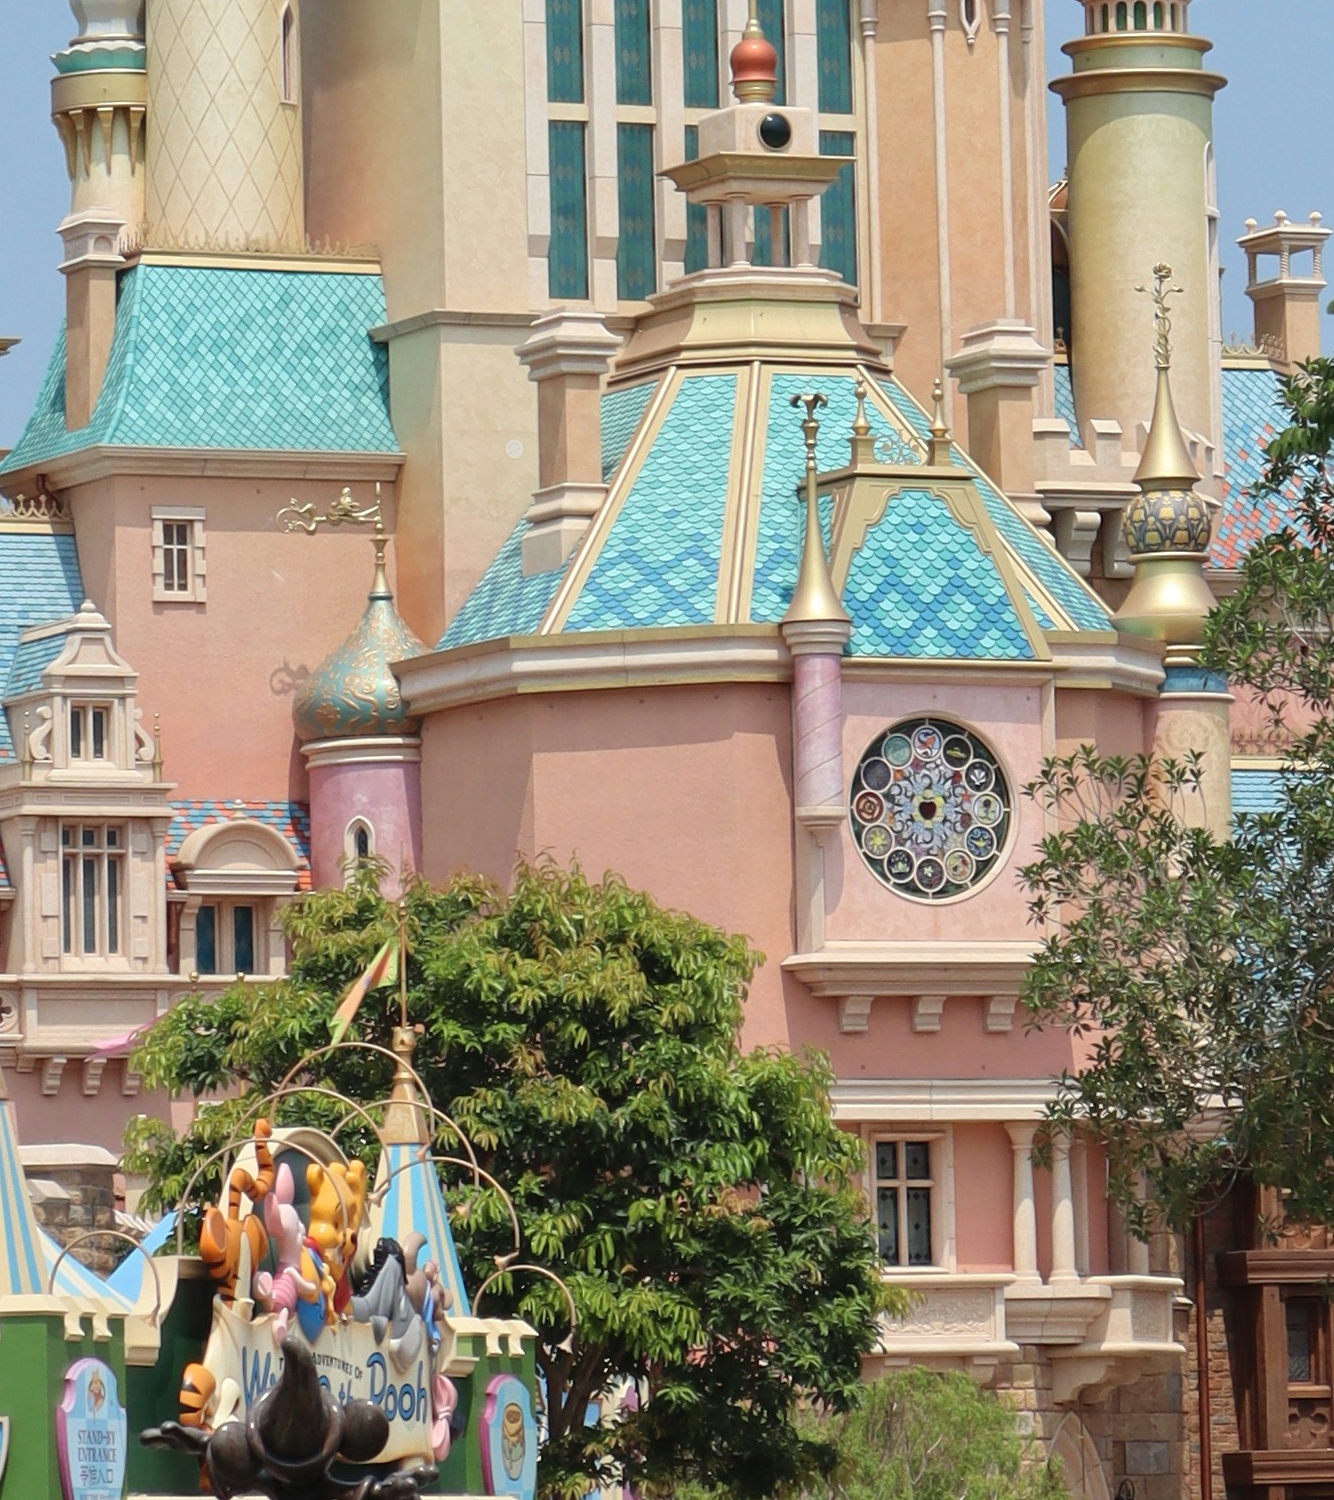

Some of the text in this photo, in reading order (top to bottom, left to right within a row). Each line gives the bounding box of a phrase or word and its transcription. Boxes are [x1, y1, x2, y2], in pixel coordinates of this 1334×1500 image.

[354, 1366, 363, 1381] OF
[367, 1352, 428, 1424] Pooh
[77, 1429, 116, 1445] STAND-BY
[77, 1447, 116, 1462] ENTRANCE
